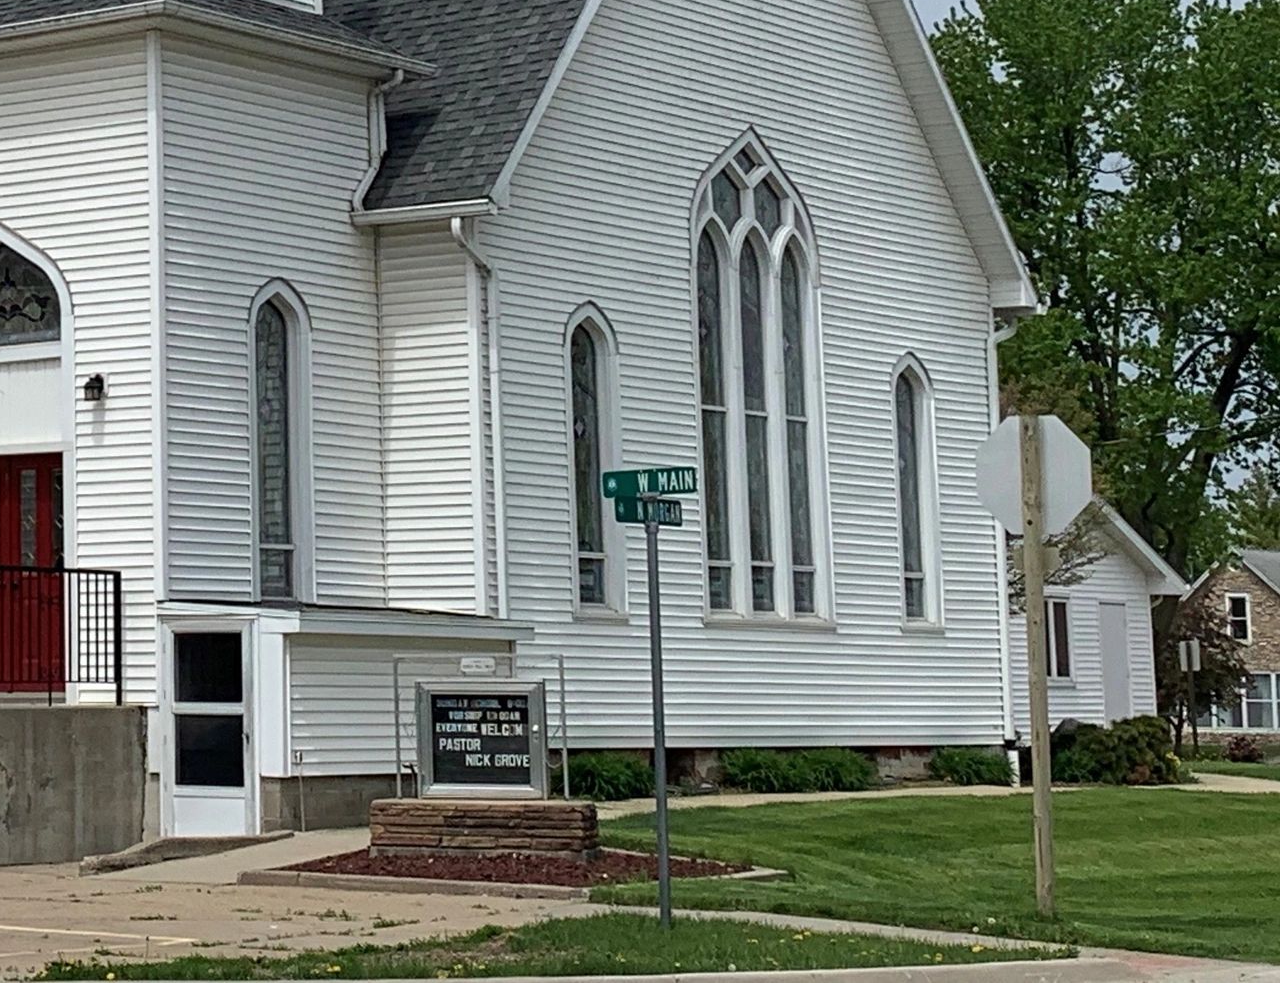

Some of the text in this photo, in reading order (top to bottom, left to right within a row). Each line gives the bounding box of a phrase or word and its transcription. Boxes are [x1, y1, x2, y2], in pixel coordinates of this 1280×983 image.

[637, 469, 694, 492] W MAIN
[436, 722, 478, 733] EVERYONE
[439, 738, 481, 751] PASTOR
[465, 754, 530, 768] NICK GROVE
